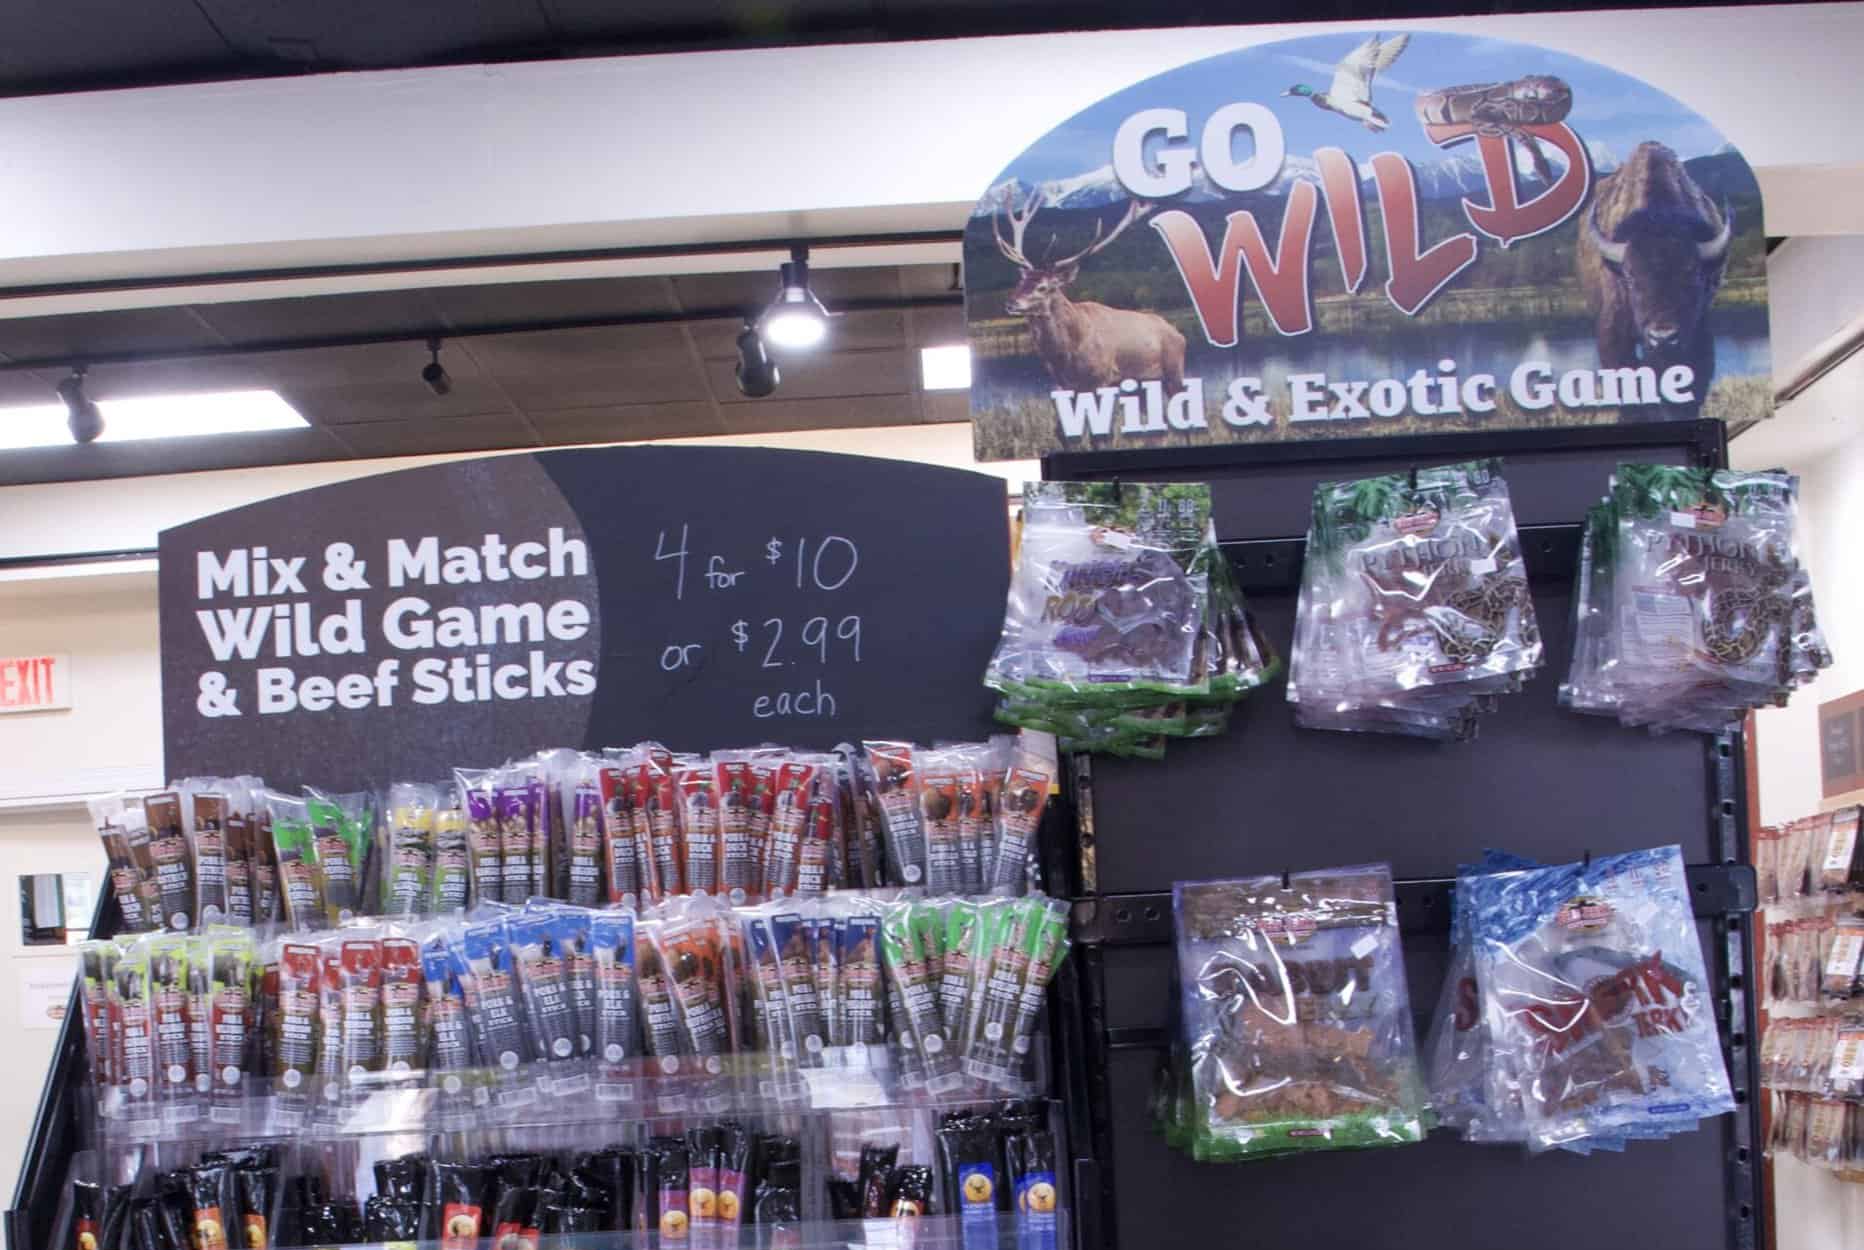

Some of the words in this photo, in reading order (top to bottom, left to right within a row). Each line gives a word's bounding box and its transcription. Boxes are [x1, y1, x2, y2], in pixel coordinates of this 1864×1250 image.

[1113, 102, 1285, 199] GO
[1149, 119, 1592, 347] WILD
[1053, 380, 1208, 438] Wild
[1223, 378, 1274, 427] &
[1289, 360, 1498, 424] Exotic
[1510, 362, 1696, 418] Game
[196, 547, 306, 600] Mix
[322, 543, 370, 591] &
[388, 527, 589, 587] Match
[654, 523, 689, 601] 4
[704, 546, 746, 590] for
[197, 604, 366, 662] Wild
[383, 596, 591, 650] Game
[660, 644, 702, 674] or
[731, 614, 864, 671] $2.99
[0, 657, 55, 706] EXIT
[196, 671, 238, 719] &
[256, 663, 402, 714] Beef
[411, 650, 598, 705] Sticks
[753, 680, 837, 720] each
